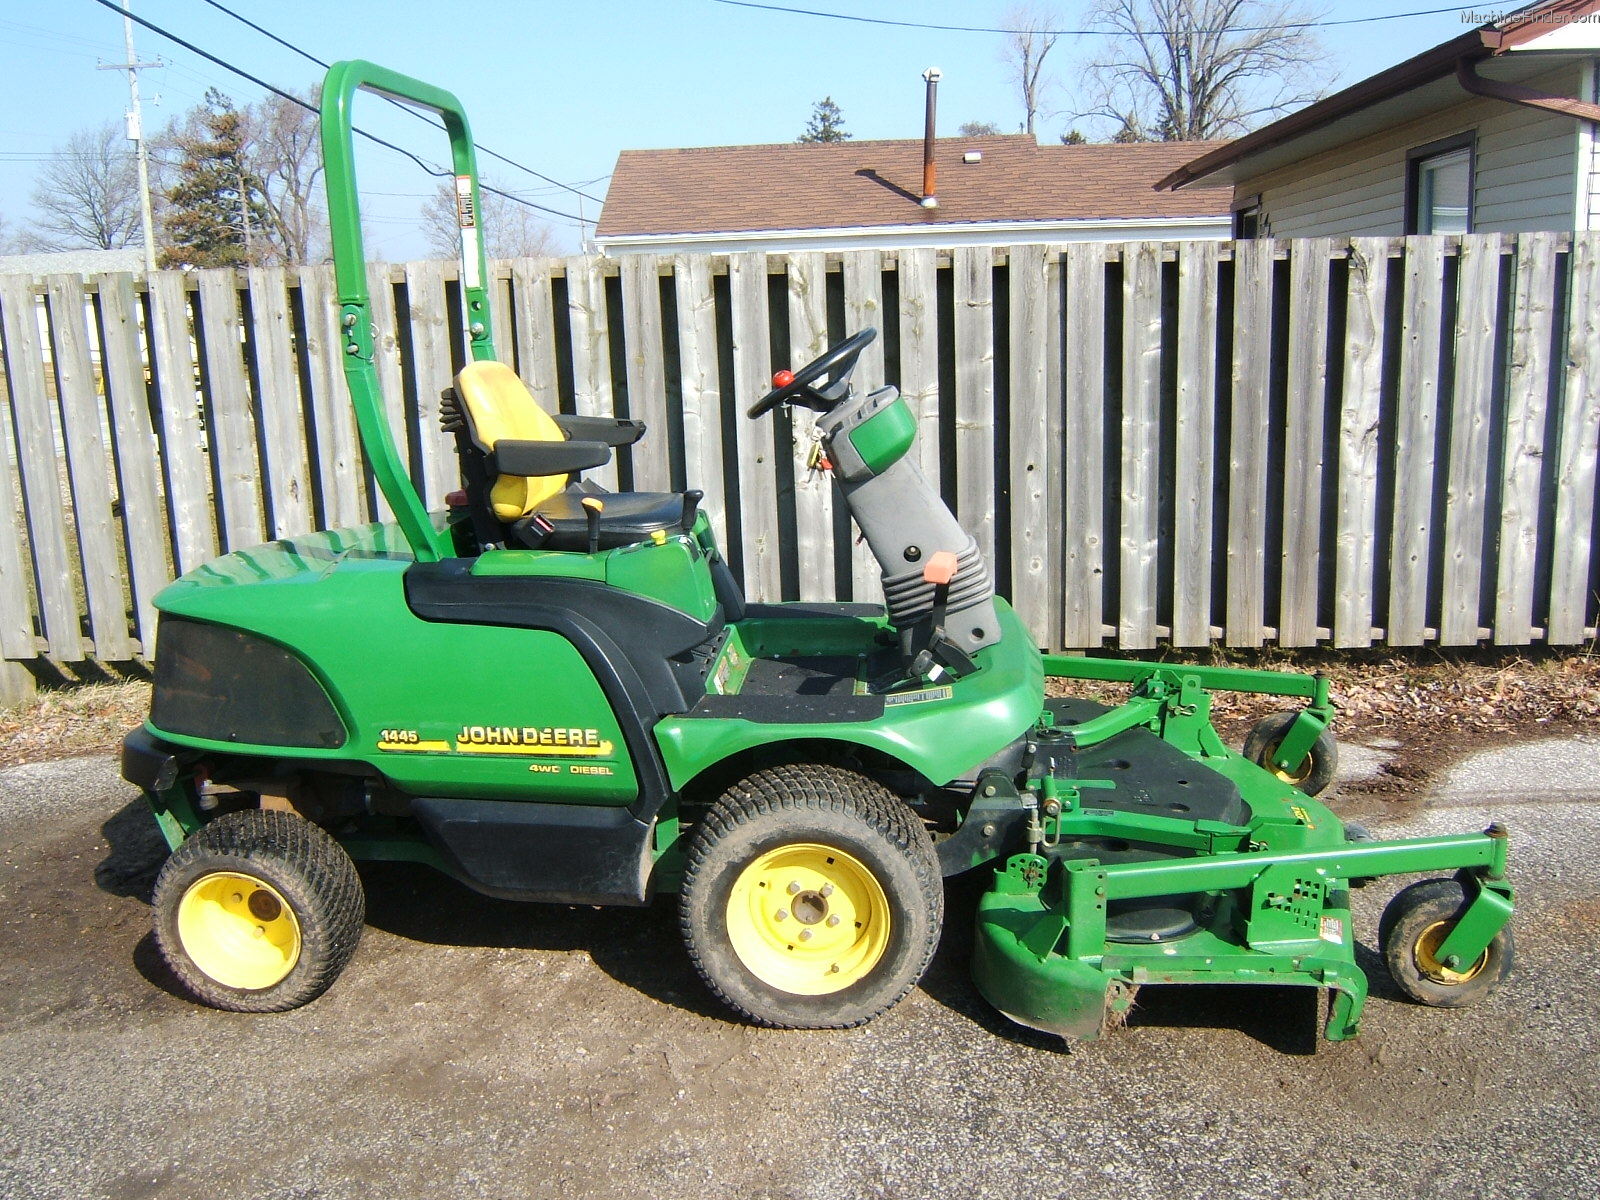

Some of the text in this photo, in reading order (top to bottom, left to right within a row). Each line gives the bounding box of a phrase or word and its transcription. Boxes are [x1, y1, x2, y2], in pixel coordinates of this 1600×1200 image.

[381, 729, 418, 743] 1445
[457, 726, 599, 746] JOHN DEERE
[570, 766, 614, 775] DIESEL
